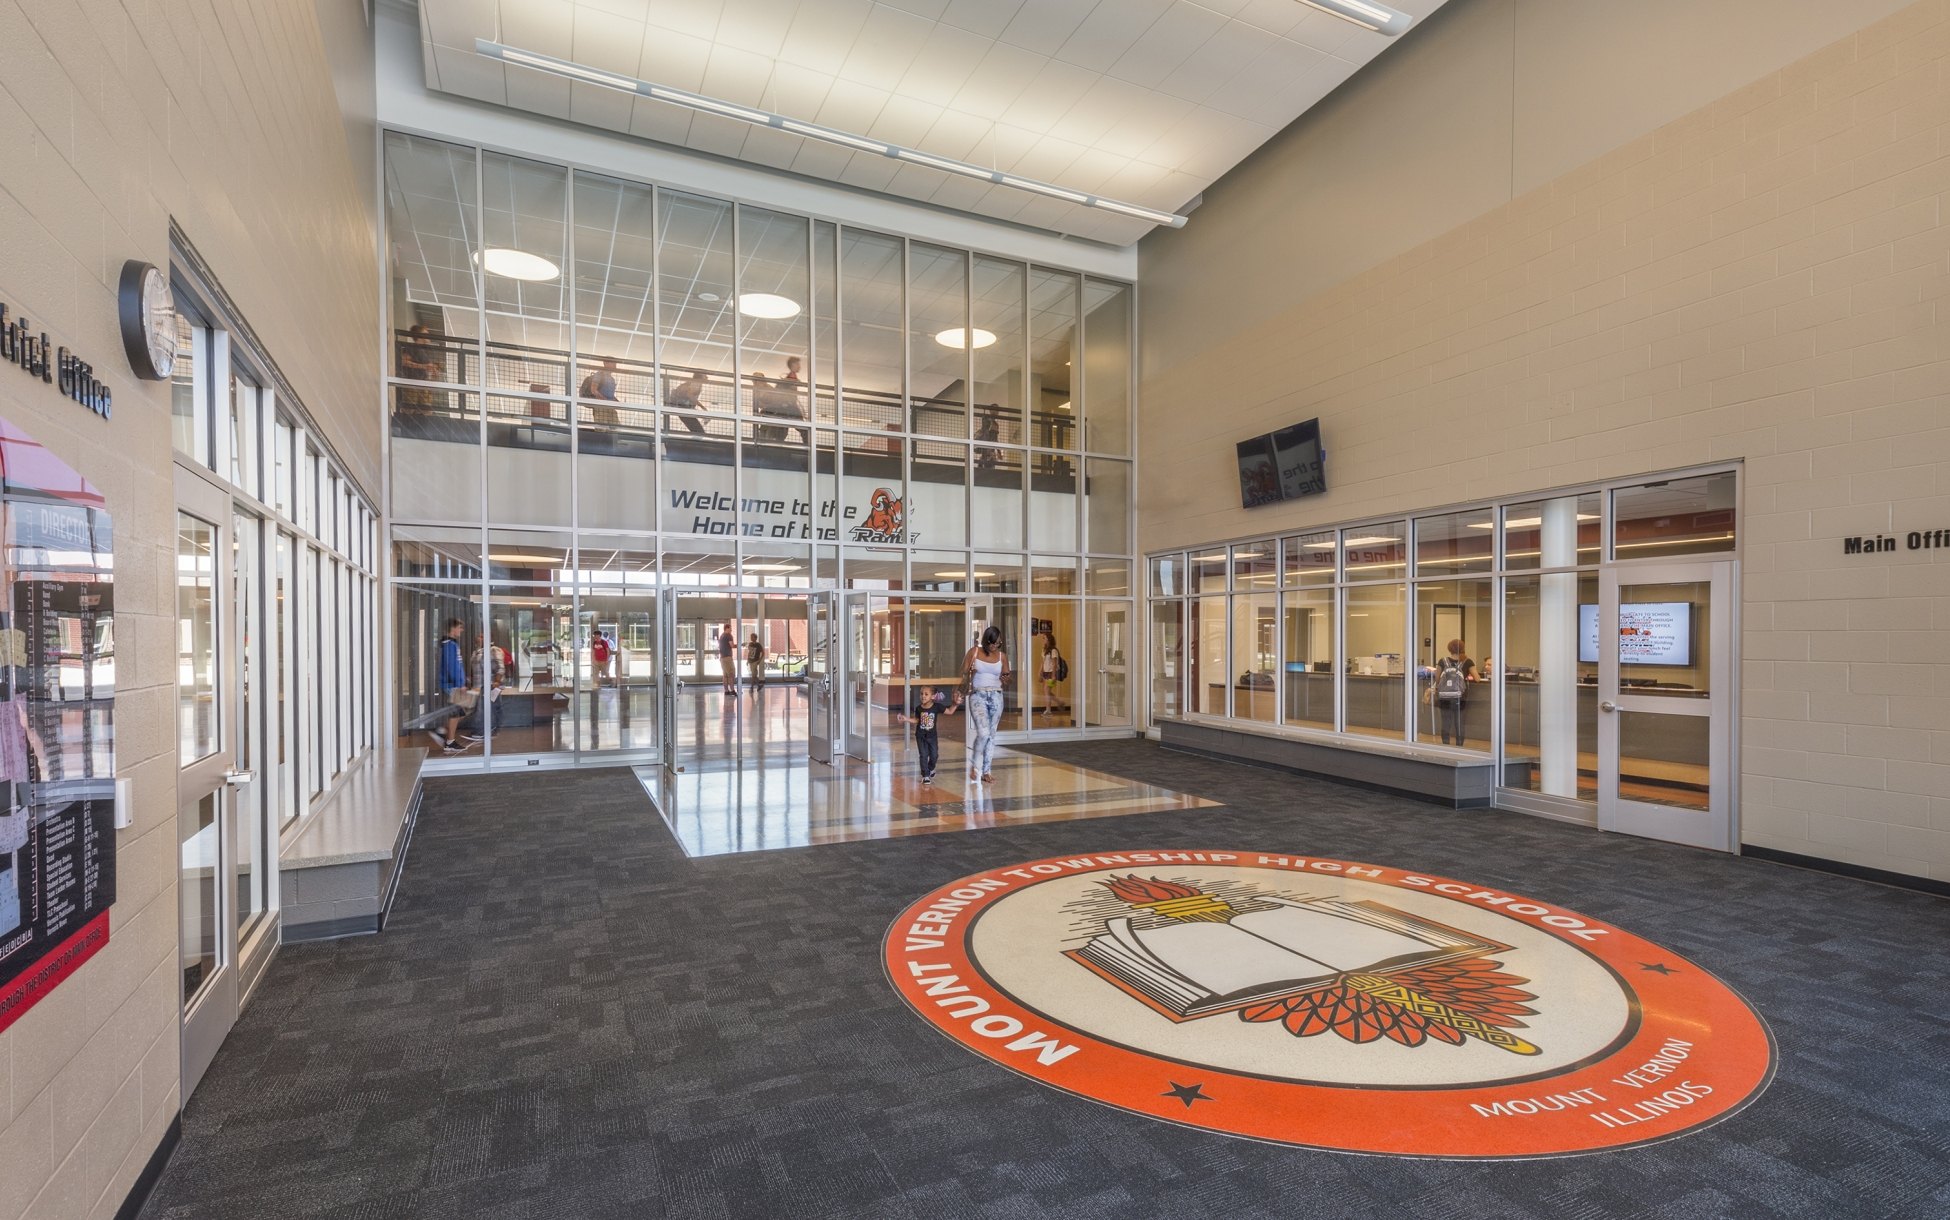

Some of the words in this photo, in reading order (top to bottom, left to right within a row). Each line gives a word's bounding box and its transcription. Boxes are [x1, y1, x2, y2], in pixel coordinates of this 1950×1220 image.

[58, 346, 112, 421] Office
[671, 489, 784, 514] Welcome
[792, 498, 810, 516] to
[691, 516, 764, 537] Home
[771, 521, 796, 538] of
[849, 526, 921, 545] Ram
[1844, 535, 1896, 554] Main
[1907, 529, 1950, 550] Offi
[46, 822, 65, 836] Presentation
[46, 832, 65, 845] Presentation
[46, 840, 65, 854] Presentation
[59, 862, 73, 874] Education
[1002, 852, 1238, 880] TOWNSHIP
[1258, 856, 1384, 878] HIGH
[47, 879, 58, 891] Student
[59, 872, 72, 884] Services
[905, 878, 1009, 952] VERNON
[1399, 875, 1610, 941] SCHOOL
[5, 944, 9, 953] E
[11, 940, 14, 949] D
[17, 936, 20, 945] C
[22, 933, 26, 942] B
[28, 929, 31, 938] A
[26, 976, 38, 996] THE
[39, 956, 64, 985] DISTRICT
[908, 961, 1080, 1066] MOUNT
[1470, 1088, 1608, 1118] MOUNT
[1612, 1038, 1694, 1090] VERNON
[1590, 1080, 1713, 1128] ILLINOIS
